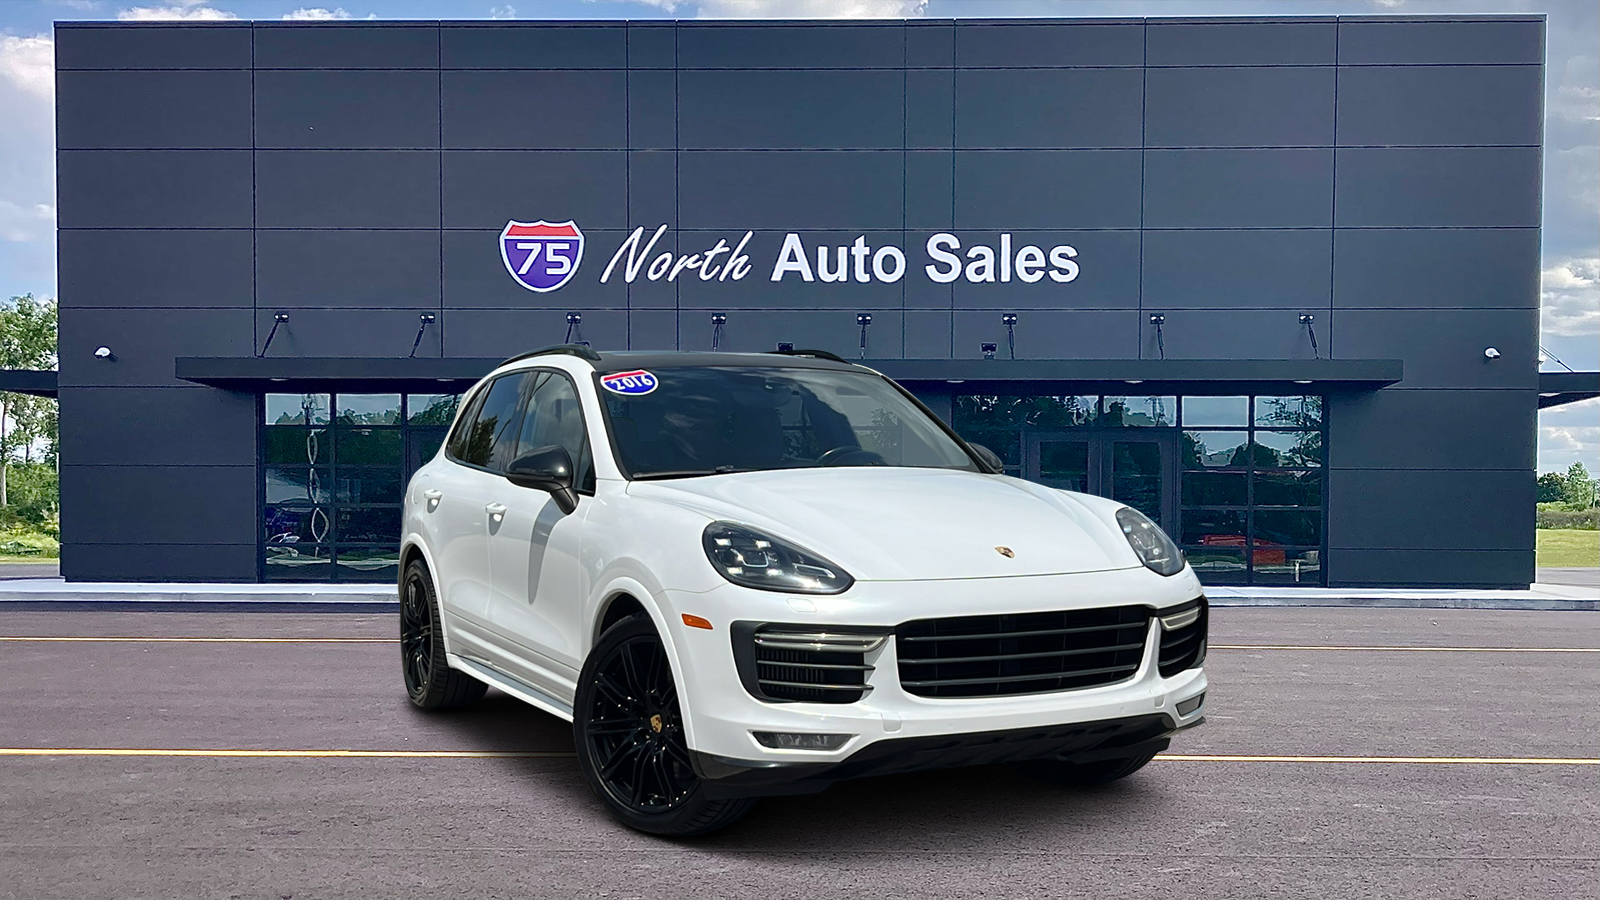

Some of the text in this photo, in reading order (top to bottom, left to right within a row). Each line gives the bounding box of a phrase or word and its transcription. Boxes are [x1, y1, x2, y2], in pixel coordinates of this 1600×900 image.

[516, 224, 1080, 284] 75 North Auto Sales
[610, 374, 653, 391] 2016
